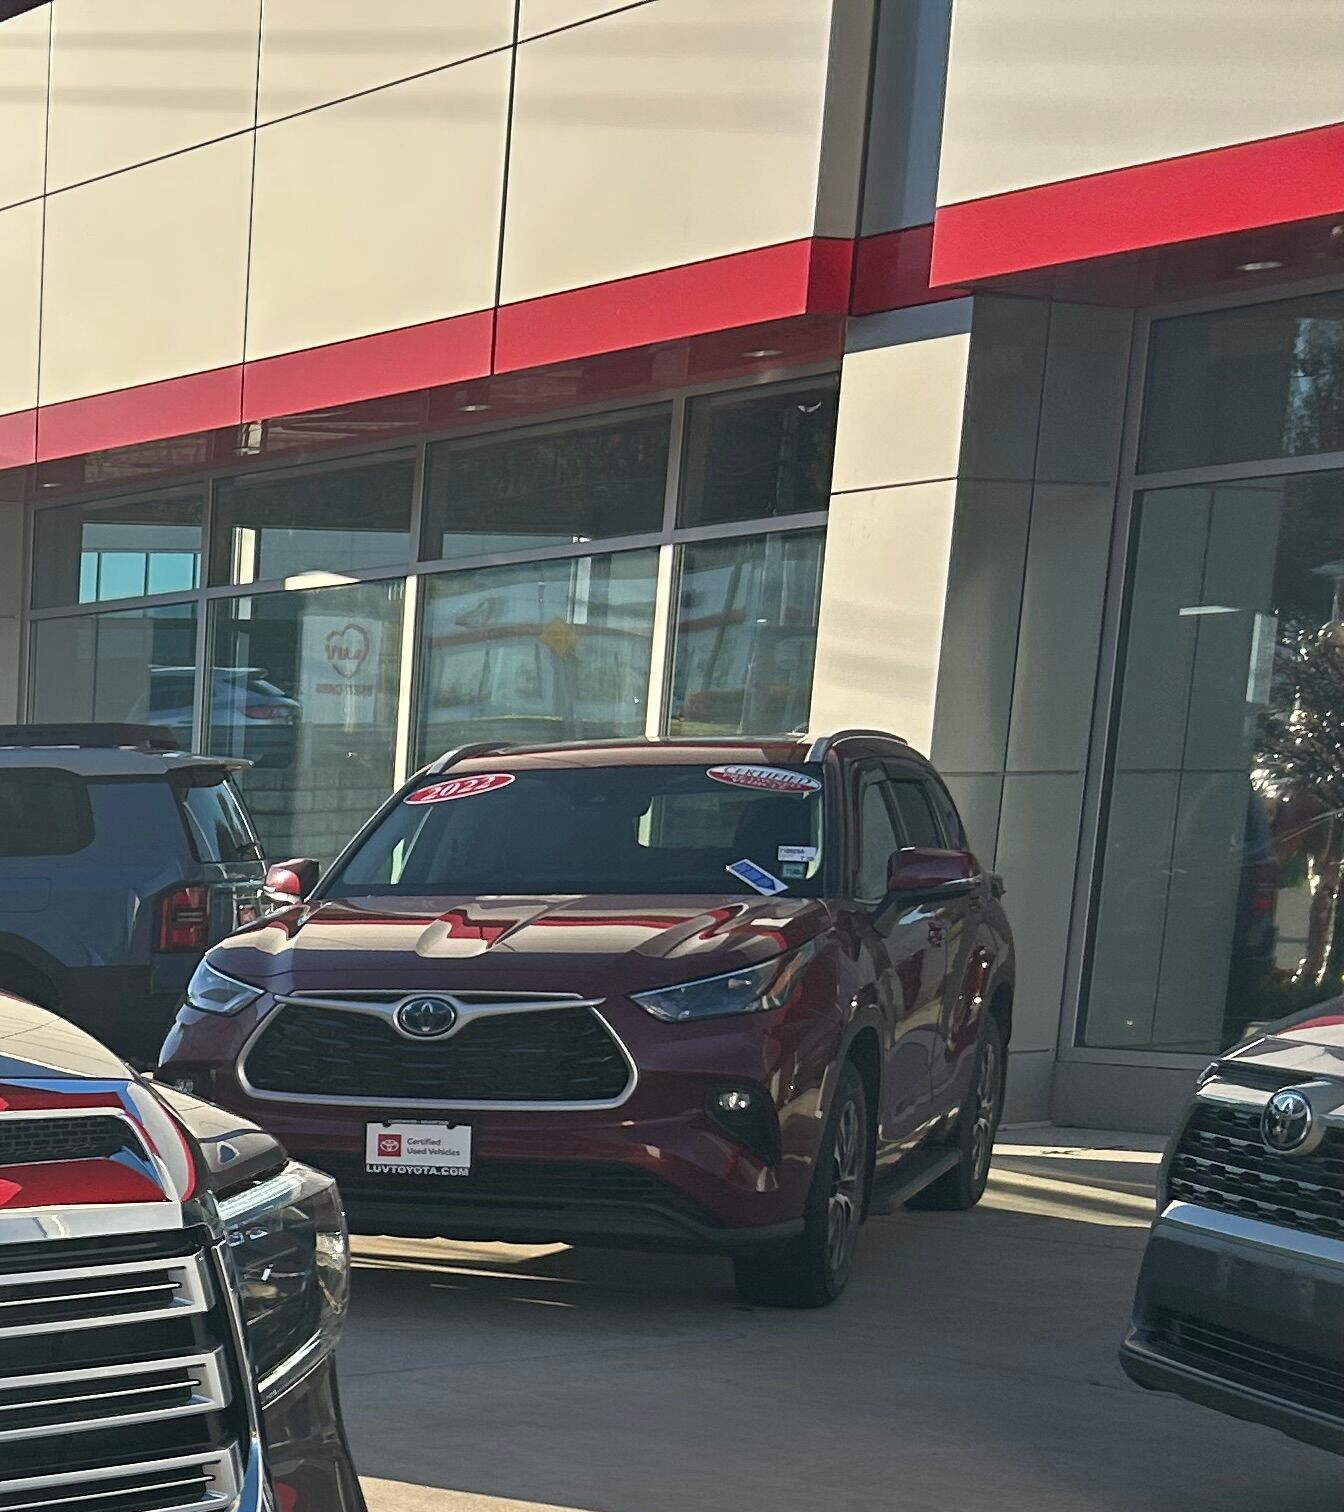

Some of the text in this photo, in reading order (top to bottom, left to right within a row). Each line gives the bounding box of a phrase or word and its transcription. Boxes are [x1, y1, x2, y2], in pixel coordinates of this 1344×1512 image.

[406, 1137, 441, 1146] Certified
[406, 1147, 461, 1157] Used Vehicles
[366, 1164, 469, 1177] LUVTOYOTA.COM
